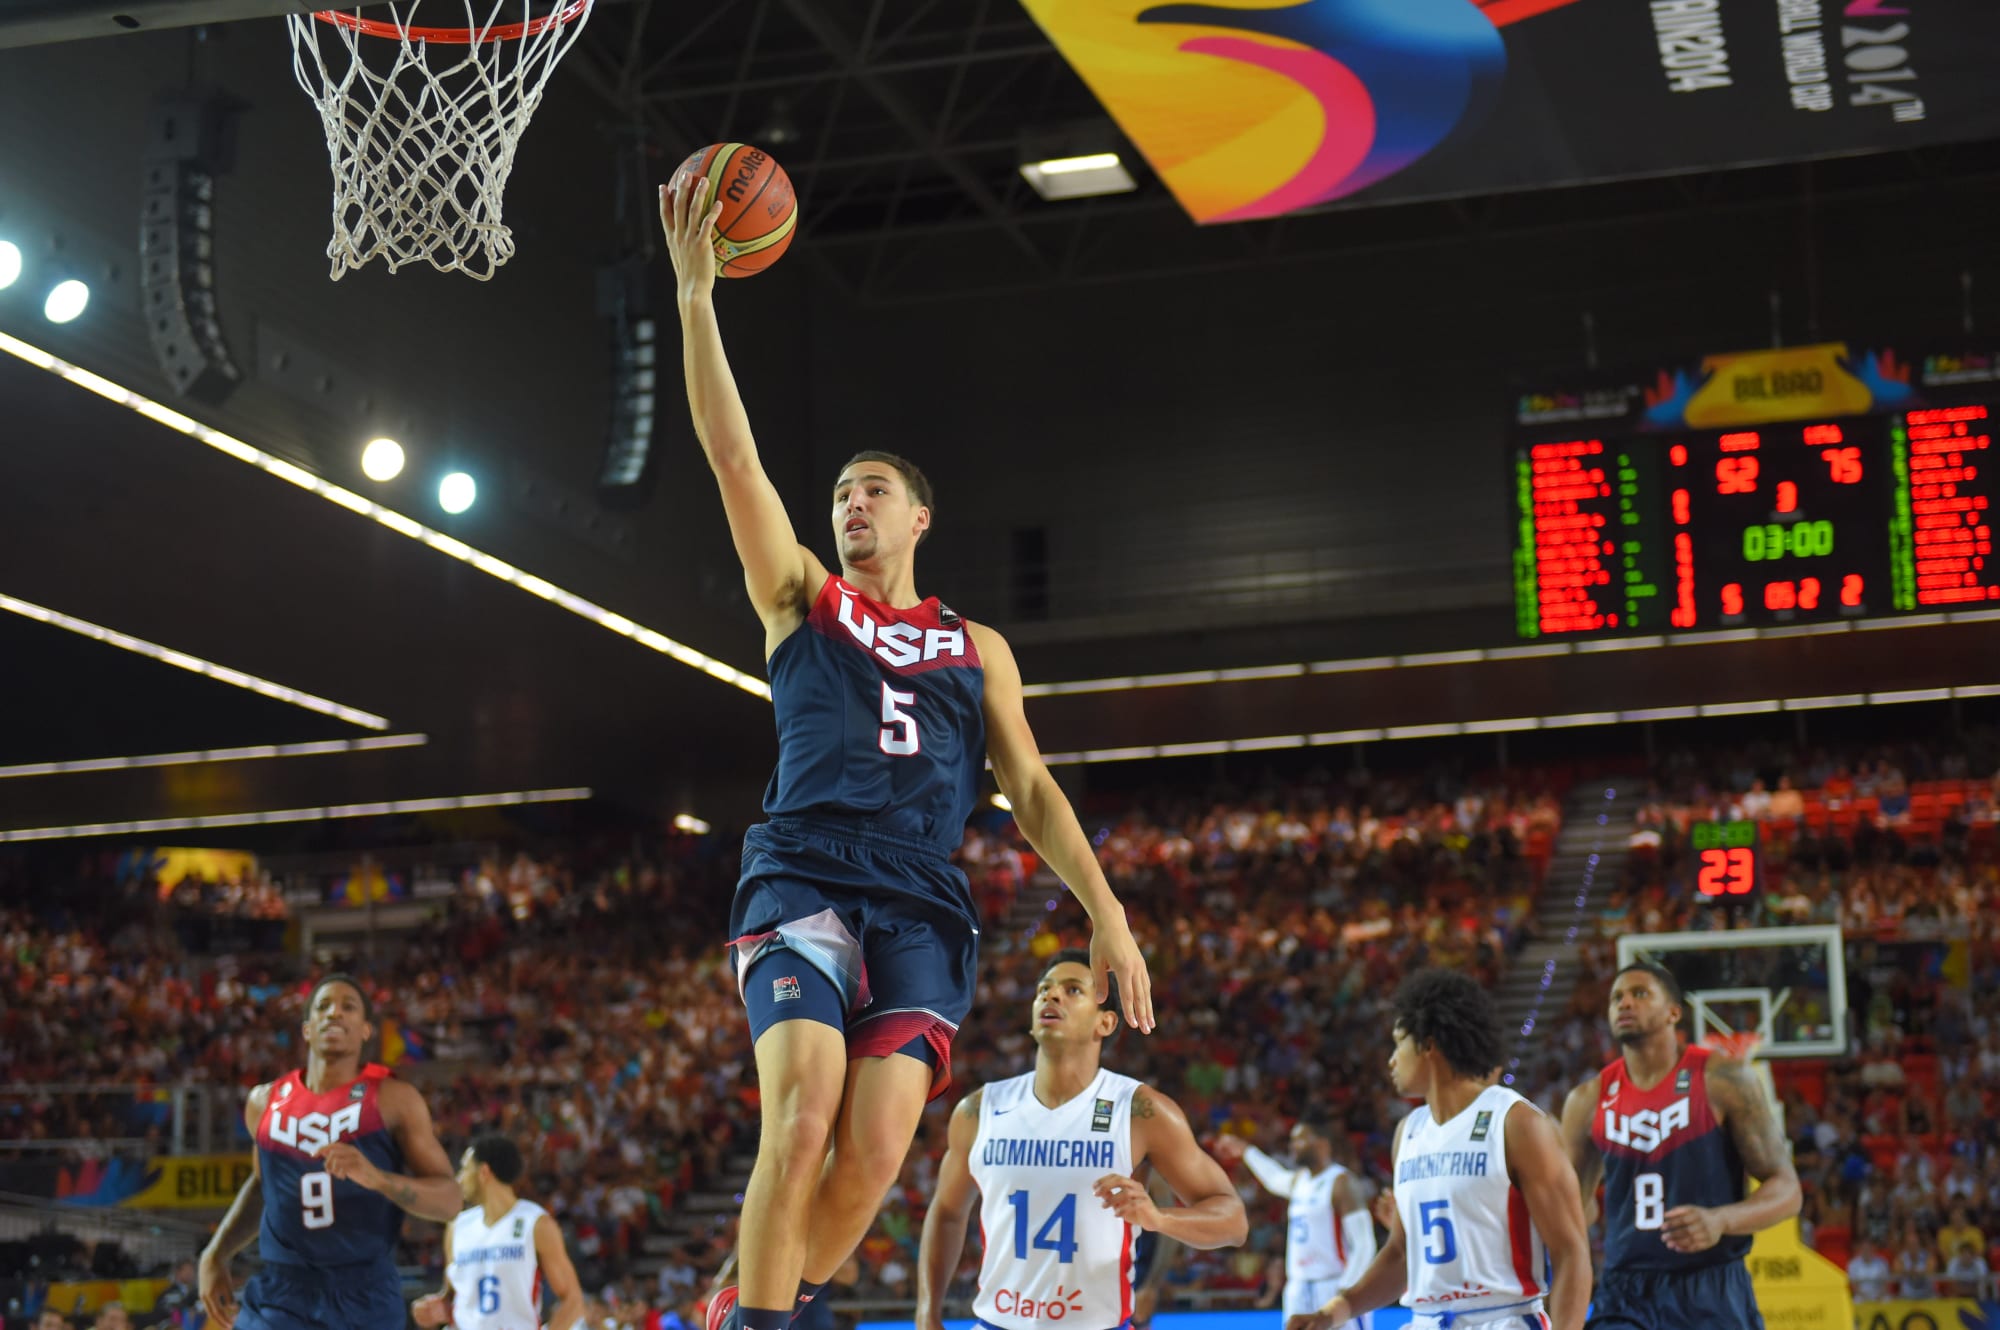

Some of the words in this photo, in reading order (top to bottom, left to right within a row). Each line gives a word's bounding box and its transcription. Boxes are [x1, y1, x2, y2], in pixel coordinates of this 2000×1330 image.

[1781, 33, 1830, 84] WORLD
[1790, 82, 1834, 112] CUP
[1734, 367, 1824, 401] BILBAO
[1742, 520, 1834, 562] 03:00
[836, 593, 966, 668] USA
[878, 680, 921, 758] 5
[1697, 847, 1755, 896] 23
[269, 1102, 362, 1157] USA
[1604, 1096, 1690, 1154] USA
[983, 1138, 1114, 1169] DOMINICANA
[301, 1171, 335, 1229] 9
[1008, 1189, 1078, 1264] 14
[1634, 1172, 1665, 1231] 8
[1419, 1199, 1458, 1265] 5
[478, 1276, 501, 1314] 6
[995, 1288, 1067, 1321] Claro
